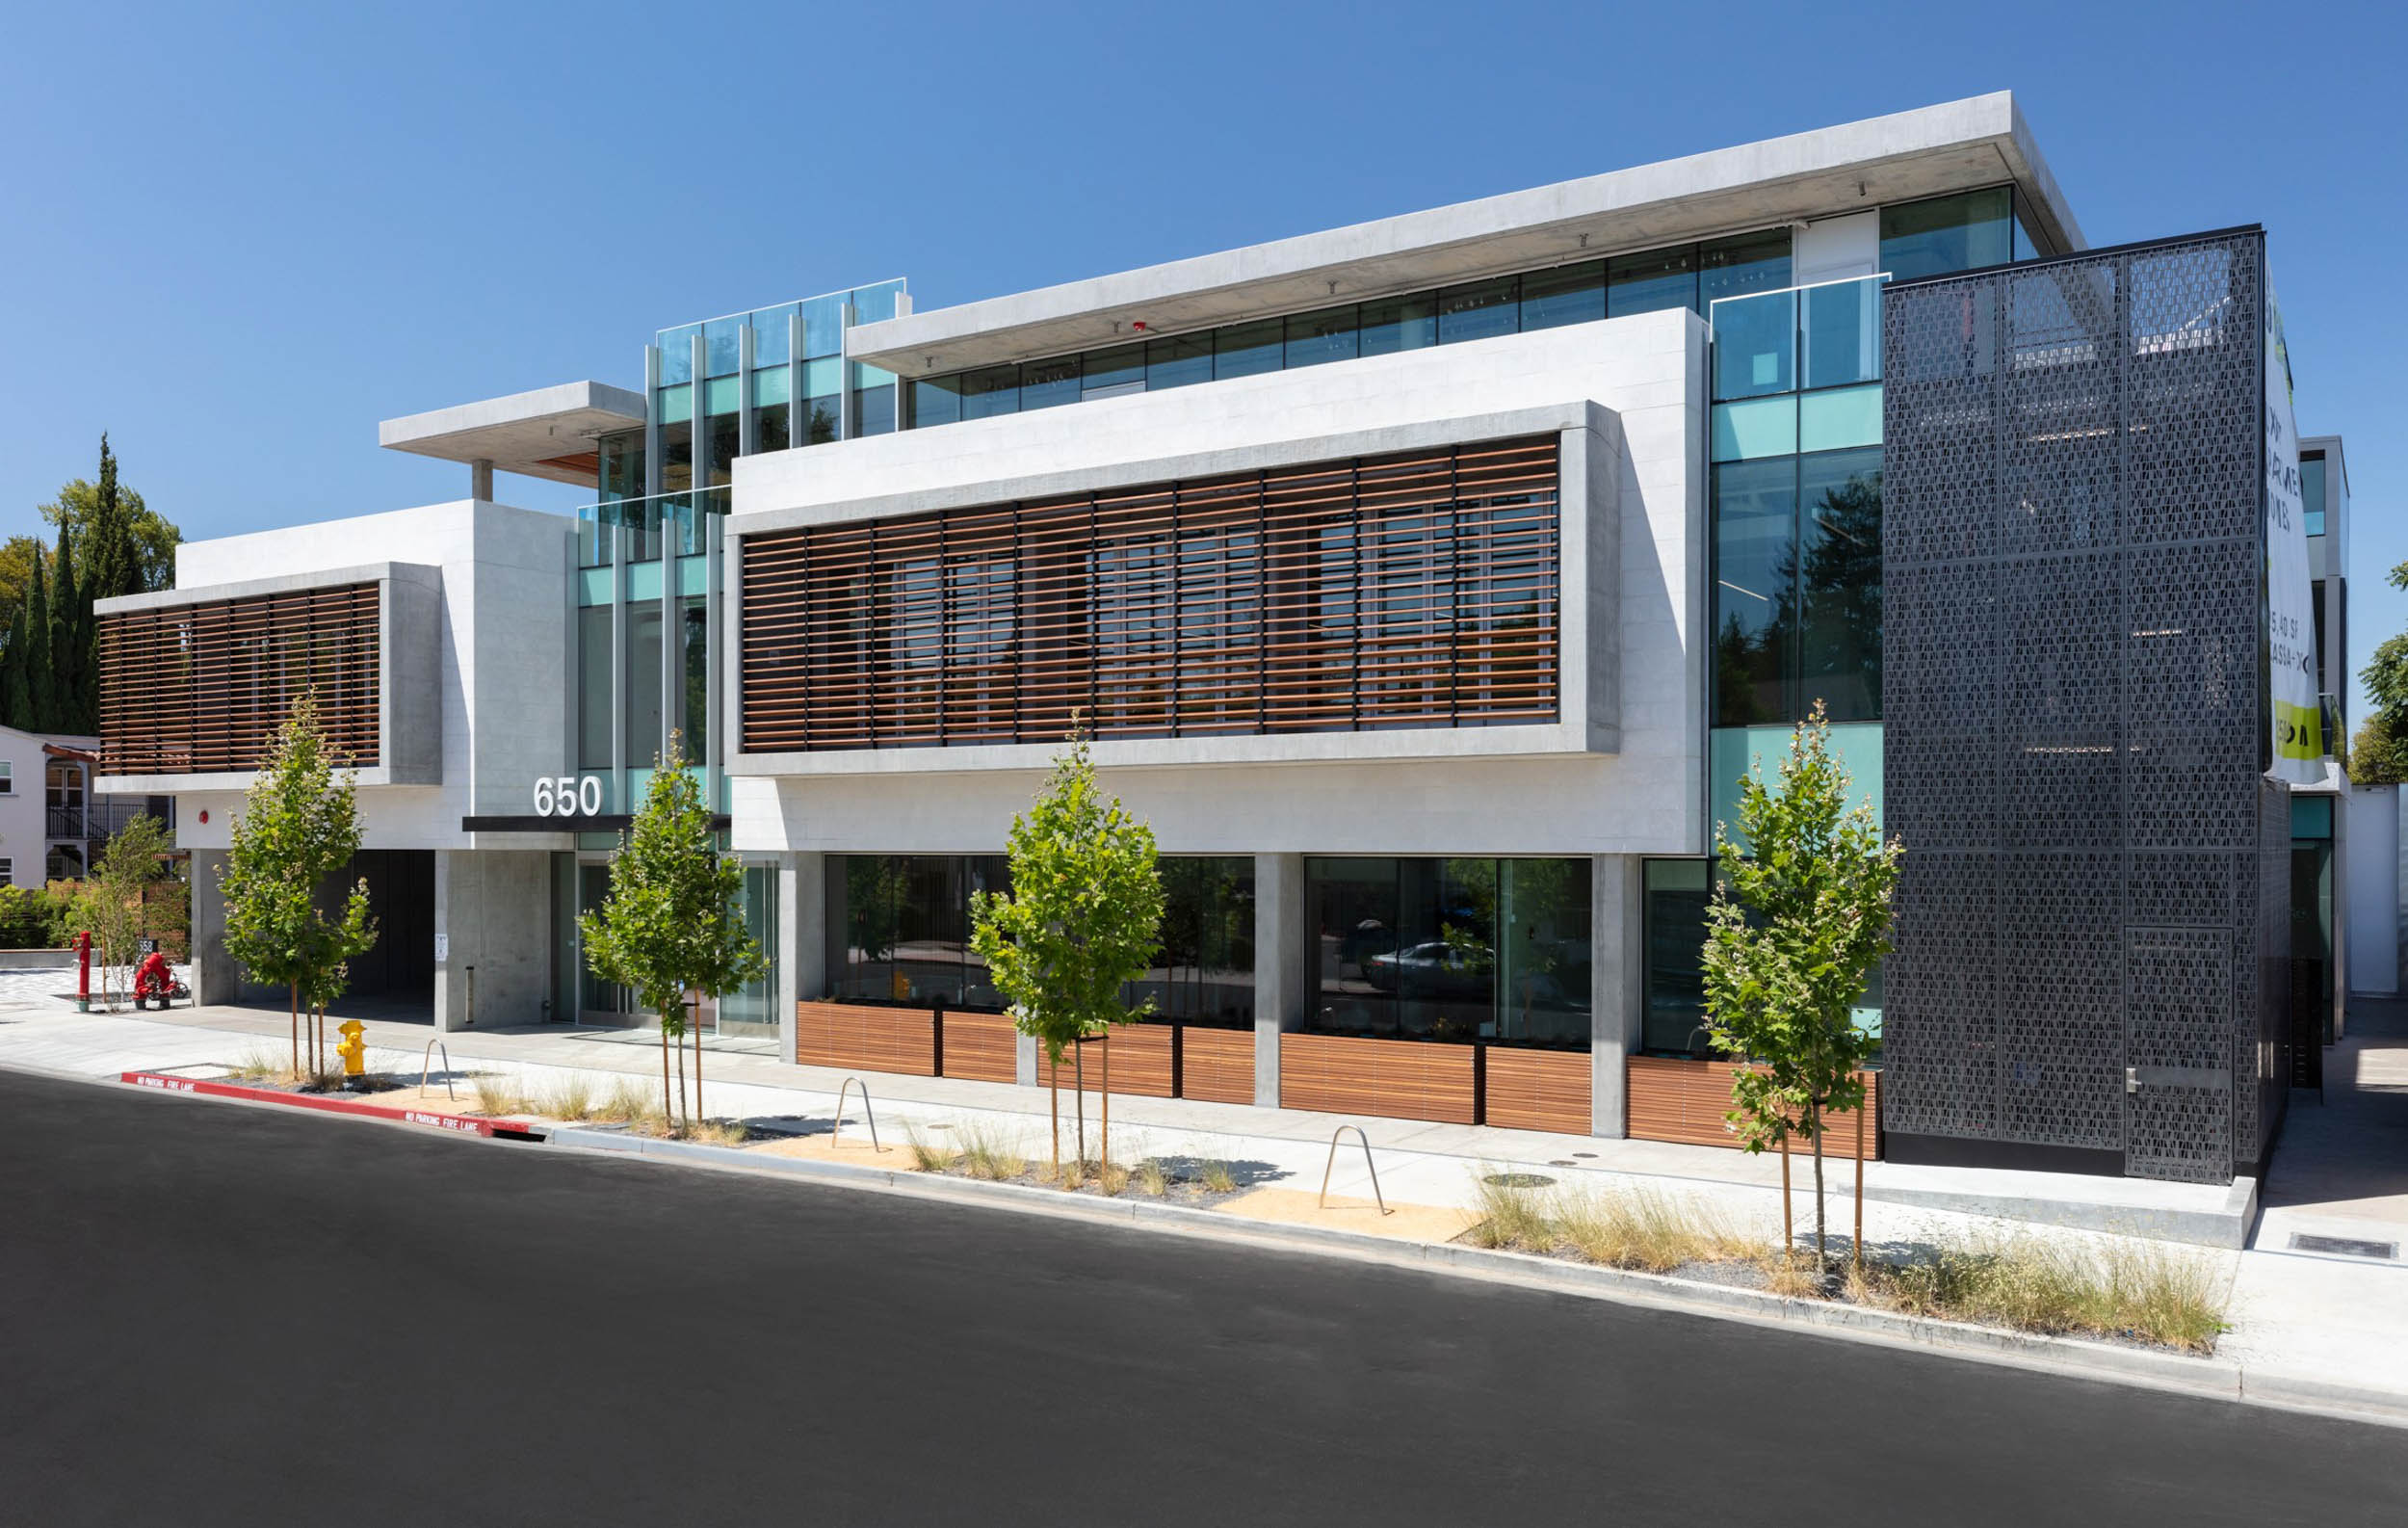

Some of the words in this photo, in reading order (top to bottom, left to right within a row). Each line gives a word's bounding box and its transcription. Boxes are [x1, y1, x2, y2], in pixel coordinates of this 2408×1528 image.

[534, 776, 602, 817] 650
[138, 1076, 144, 1087] NO
[145, 1077, 164, 1088] PARKING
[168, 1080, 179, 1090] FIRE
[180, 1082, 195, 1093] LANE
[406, 1112, 414, 1122] NO
[416, 1113, 439, 1126] PARKING
[443, 1118, 458, 1129] FIRE
[460, 1120, 478, 1132] LANE
